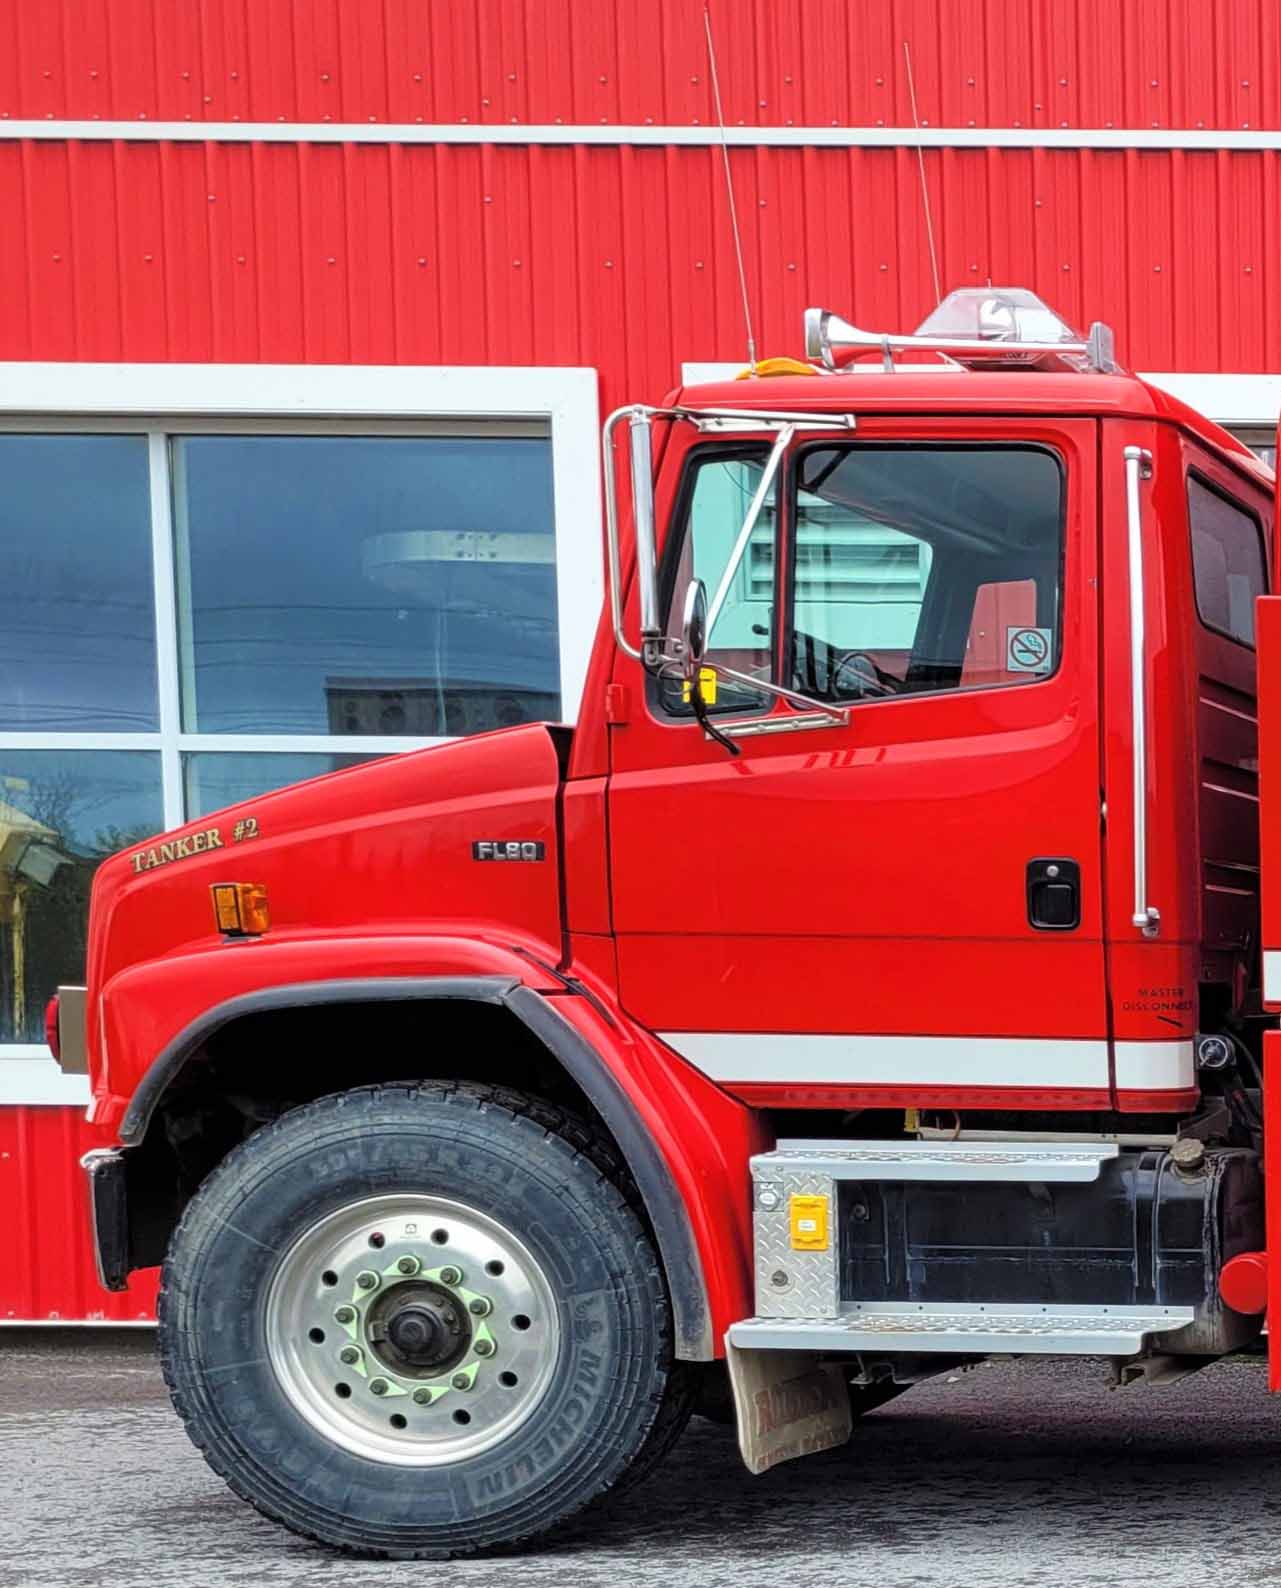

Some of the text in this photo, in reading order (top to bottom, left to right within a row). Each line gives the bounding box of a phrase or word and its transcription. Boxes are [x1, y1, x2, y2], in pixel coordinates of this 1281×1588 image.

[131, 817, 259, 874] TANKER #2
[477, 842, 537, 861] FL80
[1137, 987, 1184, 998] MASTER
[480, 1350, 601, 1496] MICHELIN
